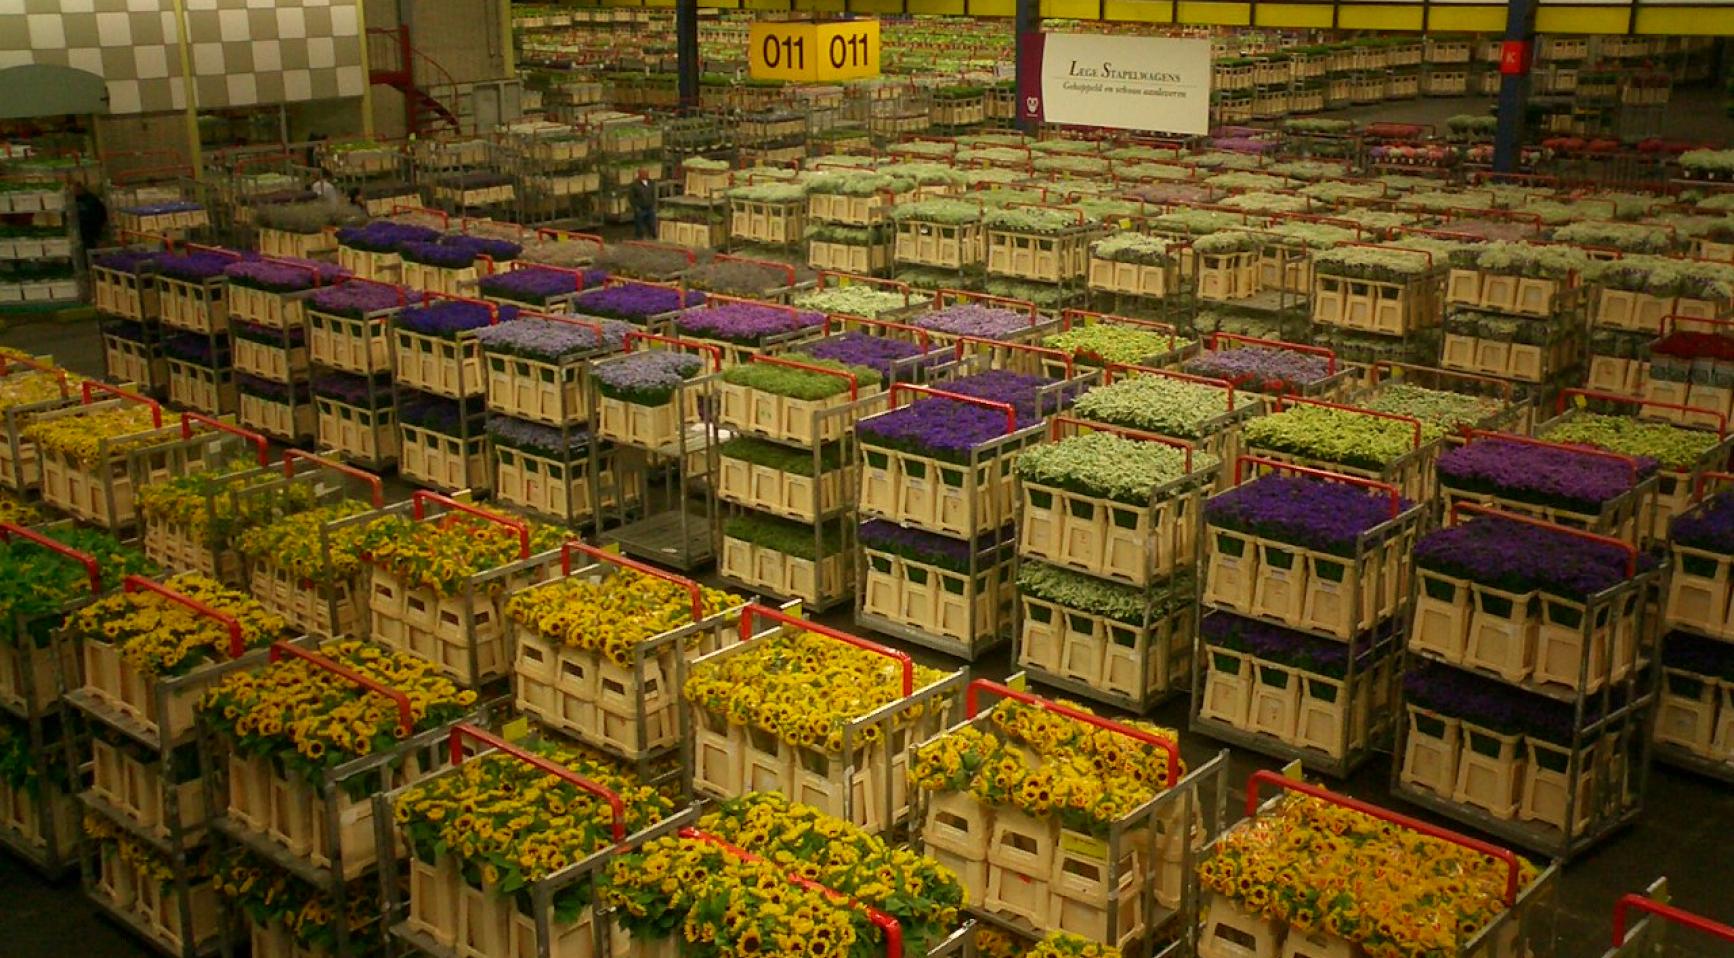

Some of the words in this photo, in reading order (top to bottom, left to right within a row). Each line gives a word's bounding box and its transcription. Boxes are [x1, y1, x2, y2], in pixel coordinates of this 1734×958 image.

[763, 34, 804, 70] 011
[829, 33, 868, 69] 011
[1069, 60, 1098, 77] LEGE
[1101, 62, 1181, 82] STAPELWAGENS
